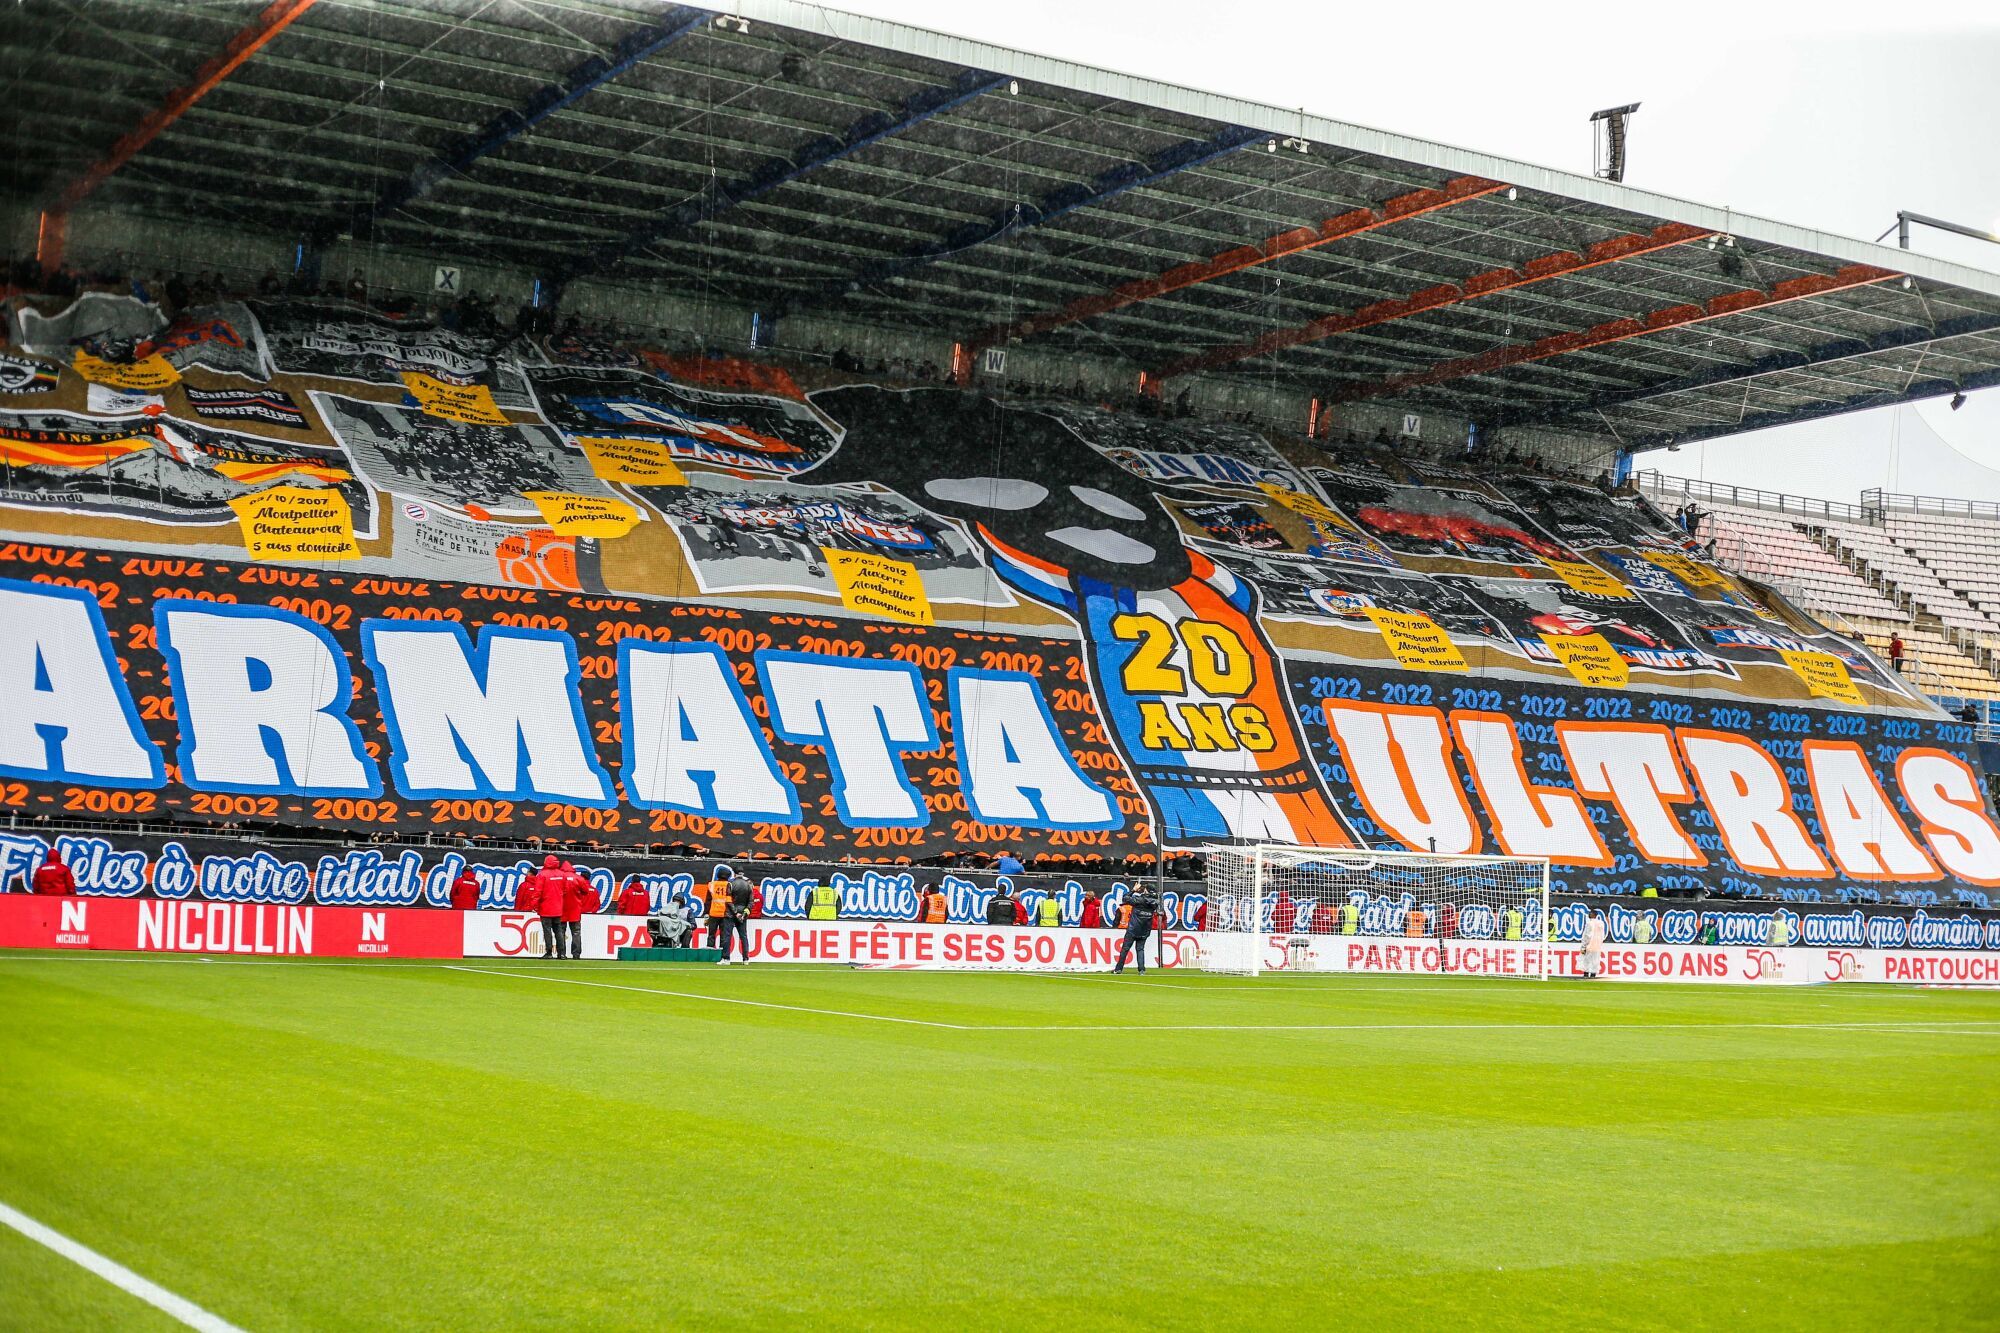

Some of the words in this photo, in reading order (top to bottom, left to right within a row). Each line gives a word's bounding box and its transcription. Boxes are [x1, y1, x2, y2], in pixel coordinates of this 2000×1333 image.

[439, 270, 456, 291] X
[988, 351, 1004, 372] W
[57, 432, 92, 443] ANS
[1408, 419, 1418, 435] V
[598, 452, 667, 468] Montpellier
[254, 506, 338, 520] Montpellier
[557, 513, 626, 524] Montpellier
[253, 523, 342, 535] Chateauroux
[253, 542, 261, 551] 5
[266, 543, 291, 552] ans
[297, 541, 352, 553] domicile
[416, 528, 445, 546] ETANG
[450, 541, 462, 552] DE
[1622, 558, 1653, 570] THE
[857, 567, 905, 586] Auxerre
[849, 581, 916, 602] Montpellier
[854, 595, 916, 618] Champions
[1390, 628, 1439, 643] Strasbourg
[701, 626, 772, 653] 2002
[889, 644, 957, 671] 2002
[982, 651, 1044, 678] 2002
[1110, 612, 1255, 698] 20
[1397, 641, 1447, 654] Montpellier
[1398, 655, 1407, 664] 15
[1808, 676, 1850, 689] Montpellier
[0, 570, 1124, 836] ARMATA
[1309, 677, 1362, 700] 2022
[1381, 683, 1433, 706] 2022
[1452, 688, 1503, 711] 2022
[1519, 695, 1567, 718] 2022
[1584, 698, 1633, 719] 2022
[1650, 700, 1694, 724] 2022
[1709, 708, 1752, 730] 2022
[1767, 712, 1812, 734] 2022
[1825, 715, 1868, 736] 2022
[1881, 720, 1921, 741] 2022
[1935, 723, 1974, 745] 2022
[1138, 700, 1278, 752] ANS
[1322, 696, 2000, 886] ULTRAS
[65, 788, 157, 813] 2002
[191, 794, 279, 817] 2002
[313, 799, 399, 823] 2002
[431, 801, 515, 824] 2002
[544, 804, 621, 833] 2002
[649, 810, 724, 839] 2002
[754, 824, 825, 847] 2002
[853, 828, 925, 848] 2002
[0, 834, 147, 897] Fièles
[153, 843, 197, 898] à
[200, 855, 310, 903] notre
[314, 850, 423, 906] idéal
[1458, 903, 1496, 939] en
[1661, 908, 1698, 944] ces
[1803, 909, 1867, 949] avant
[1867, 914, 1908, 949] que
[1908, 909, 1984, 949] demain
[60, 901, 87, 931] N
[138, 899, 313, 954] NICOLLIN
[361, 912, 386, 942] N
[55, 933, 89, 945] NICOLLIN
[357, 943, 389, 953] NICOLLIN
[850, 922, 934, 960] FÊTE
[942, 932, 1005, 962] SES
[1014, 935, 1056, 964] 50
[1061, 936, 1134, 966] ANS
[1347, 944, 1516, 974] PARTOUCHE
[1643, 952, 1673, 977] 50
[1679, 953, 1728, 977] ANS
[1743, 949, 1777, 980] 50
[1825, 950, 1856, 980] 50
